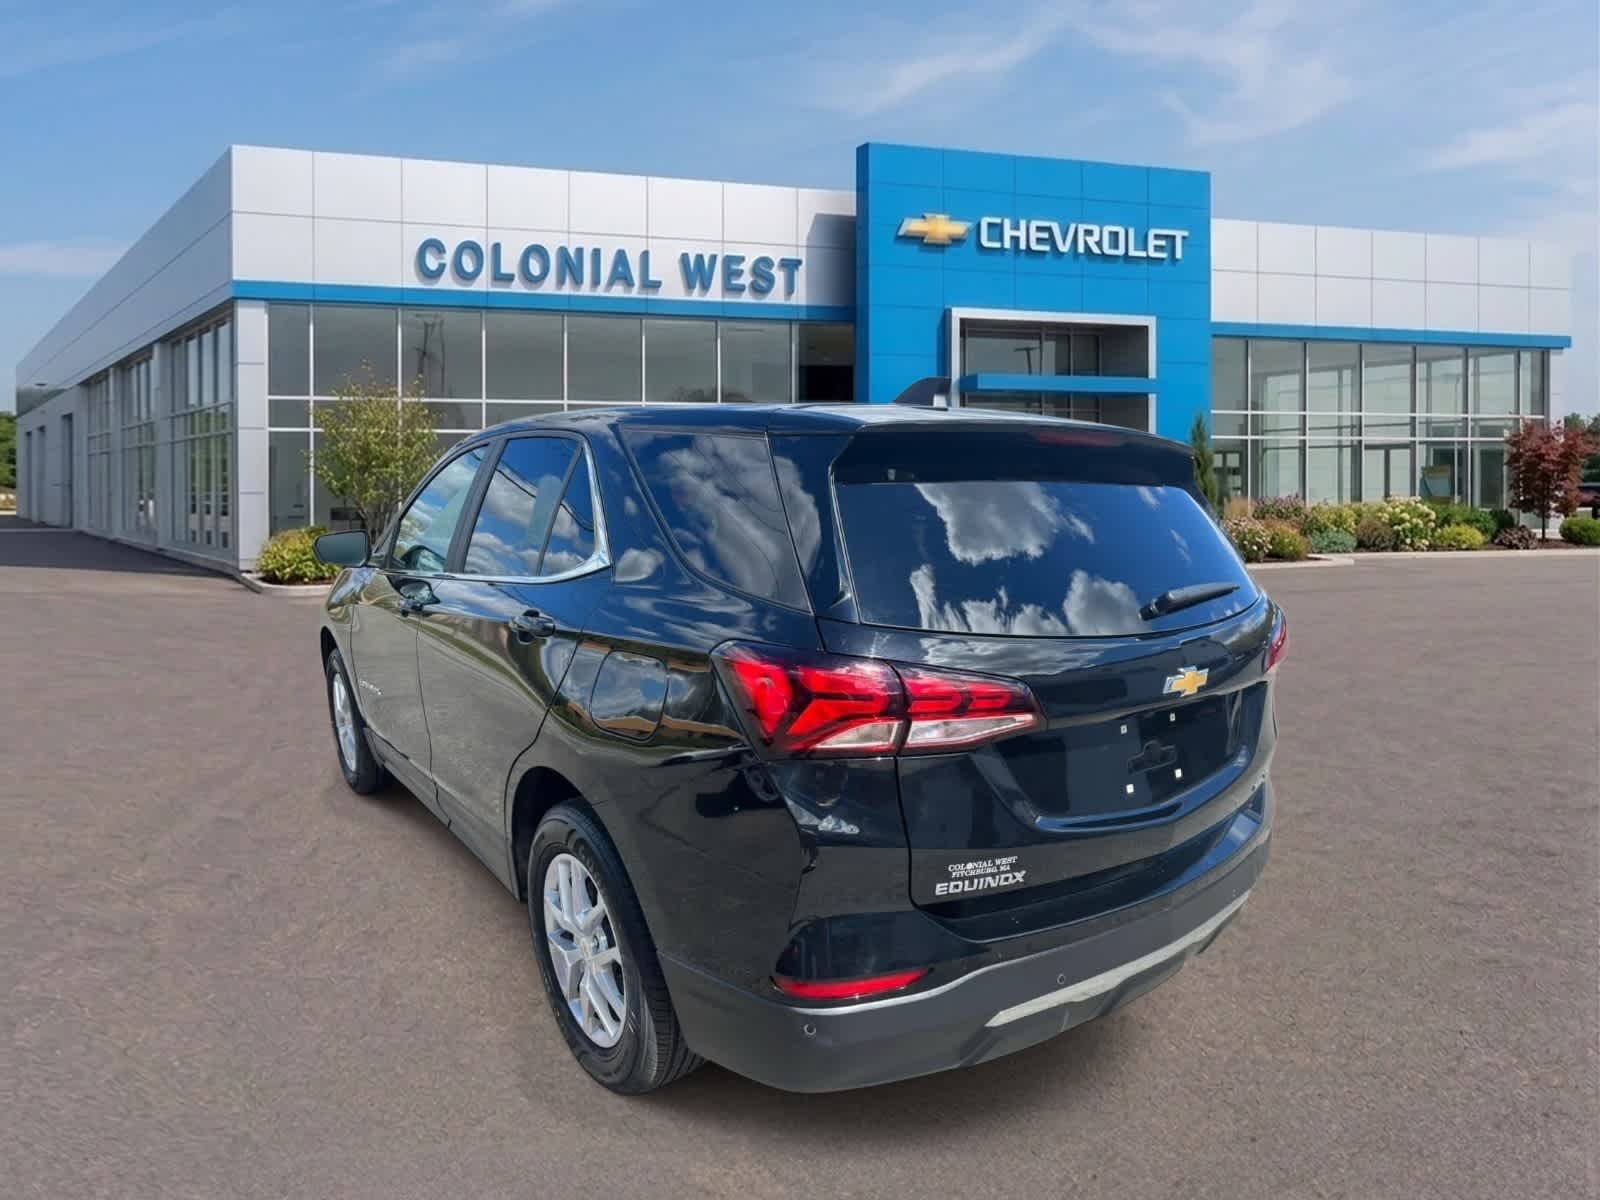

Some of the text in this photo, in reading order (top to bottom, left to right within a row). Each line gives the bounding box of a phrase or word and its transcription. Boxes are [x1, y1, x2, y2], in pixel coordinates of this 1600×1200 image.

[979, 216, 1189, 260] CHEVROLET
[415, 238, 803, 296] COLONIAL WEST
[948, 856, 1018, 872] COLONIAL WEST
[935, 870, 1026, 896] EQUINOX
